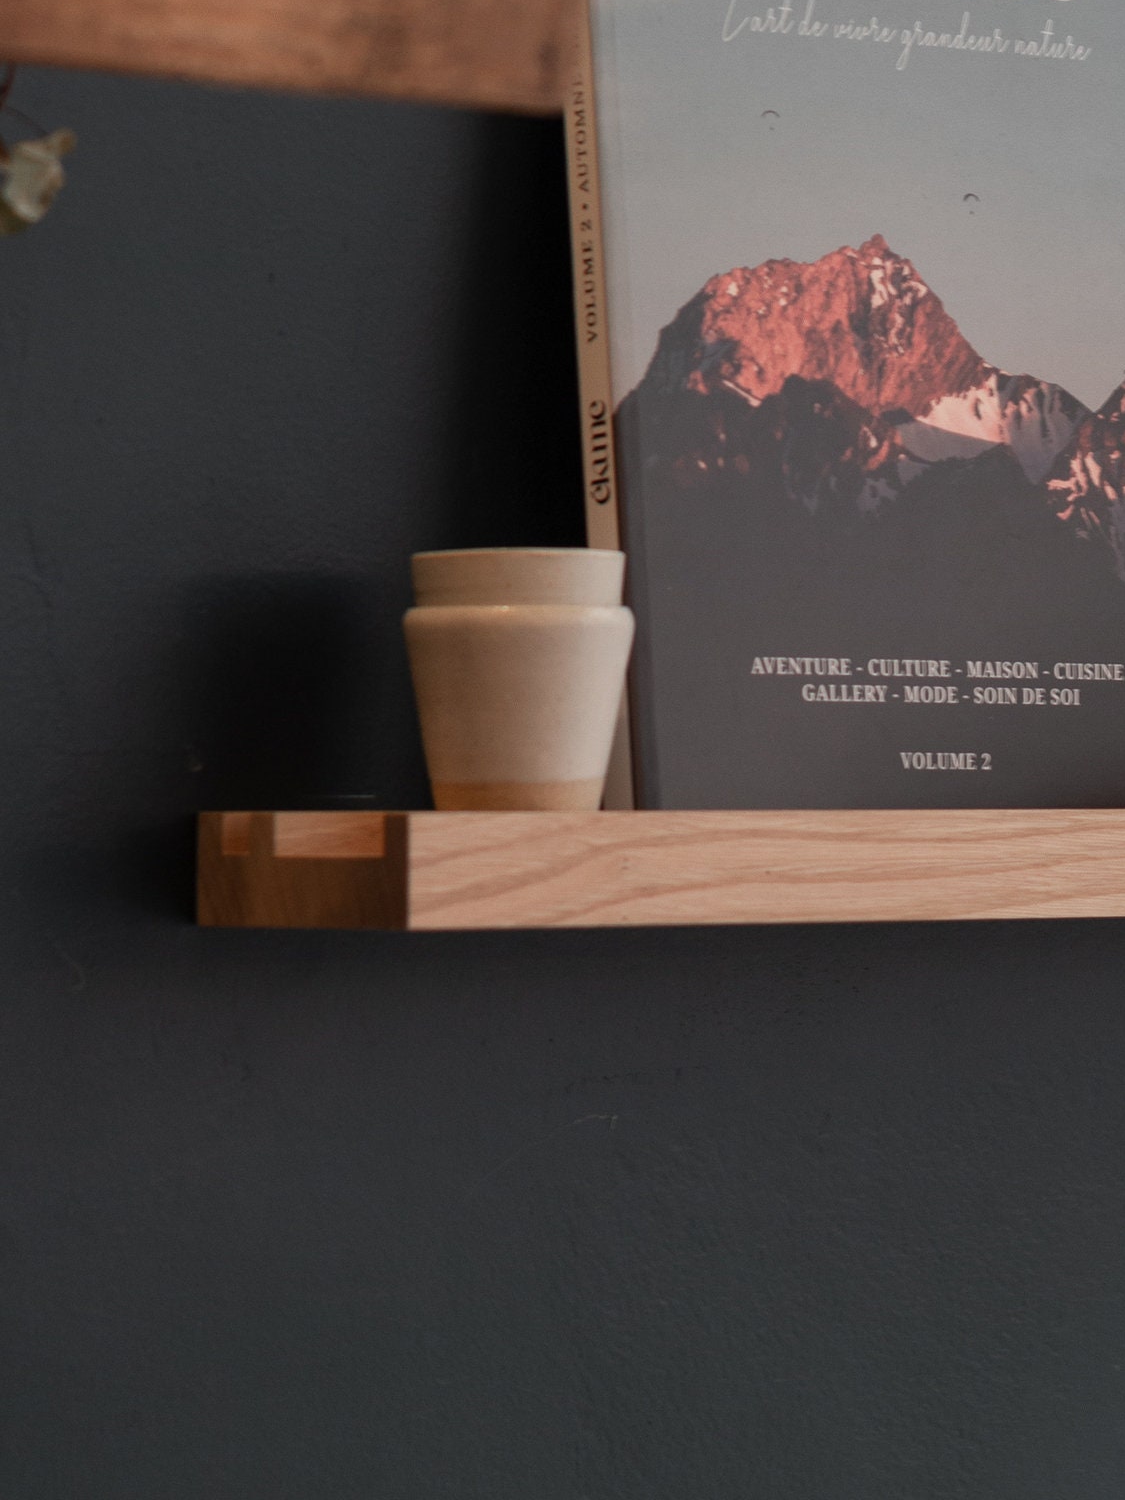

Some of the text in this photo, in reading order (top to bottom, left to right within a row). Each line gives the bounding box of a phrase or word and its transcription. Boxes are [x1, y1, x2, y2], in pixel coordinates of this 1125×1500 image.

[896, 12, 1011, 70] grandeur
[1014, 19, 1092, 60] nature
[580, 219, 593, 231] 2
[582, 239, 598, 343] VOLUME
[751, 656, 853, 676] AVENTURE
[867, 658, 951, 678] CULTURE
[966, 660, 1039, 679] MAISON
[1053, 662, 1125, 681] CUISINE
[802, 684, 888, 702] GALLERY
[904, 686, 959, 704] MODE
[973, 687, 1018, 705] SOIN
[1022, 688, 1045, 705] DE
[1050, 688, 1081, 706] SOI
[900, 752, 992, 771] VOLUME 2
